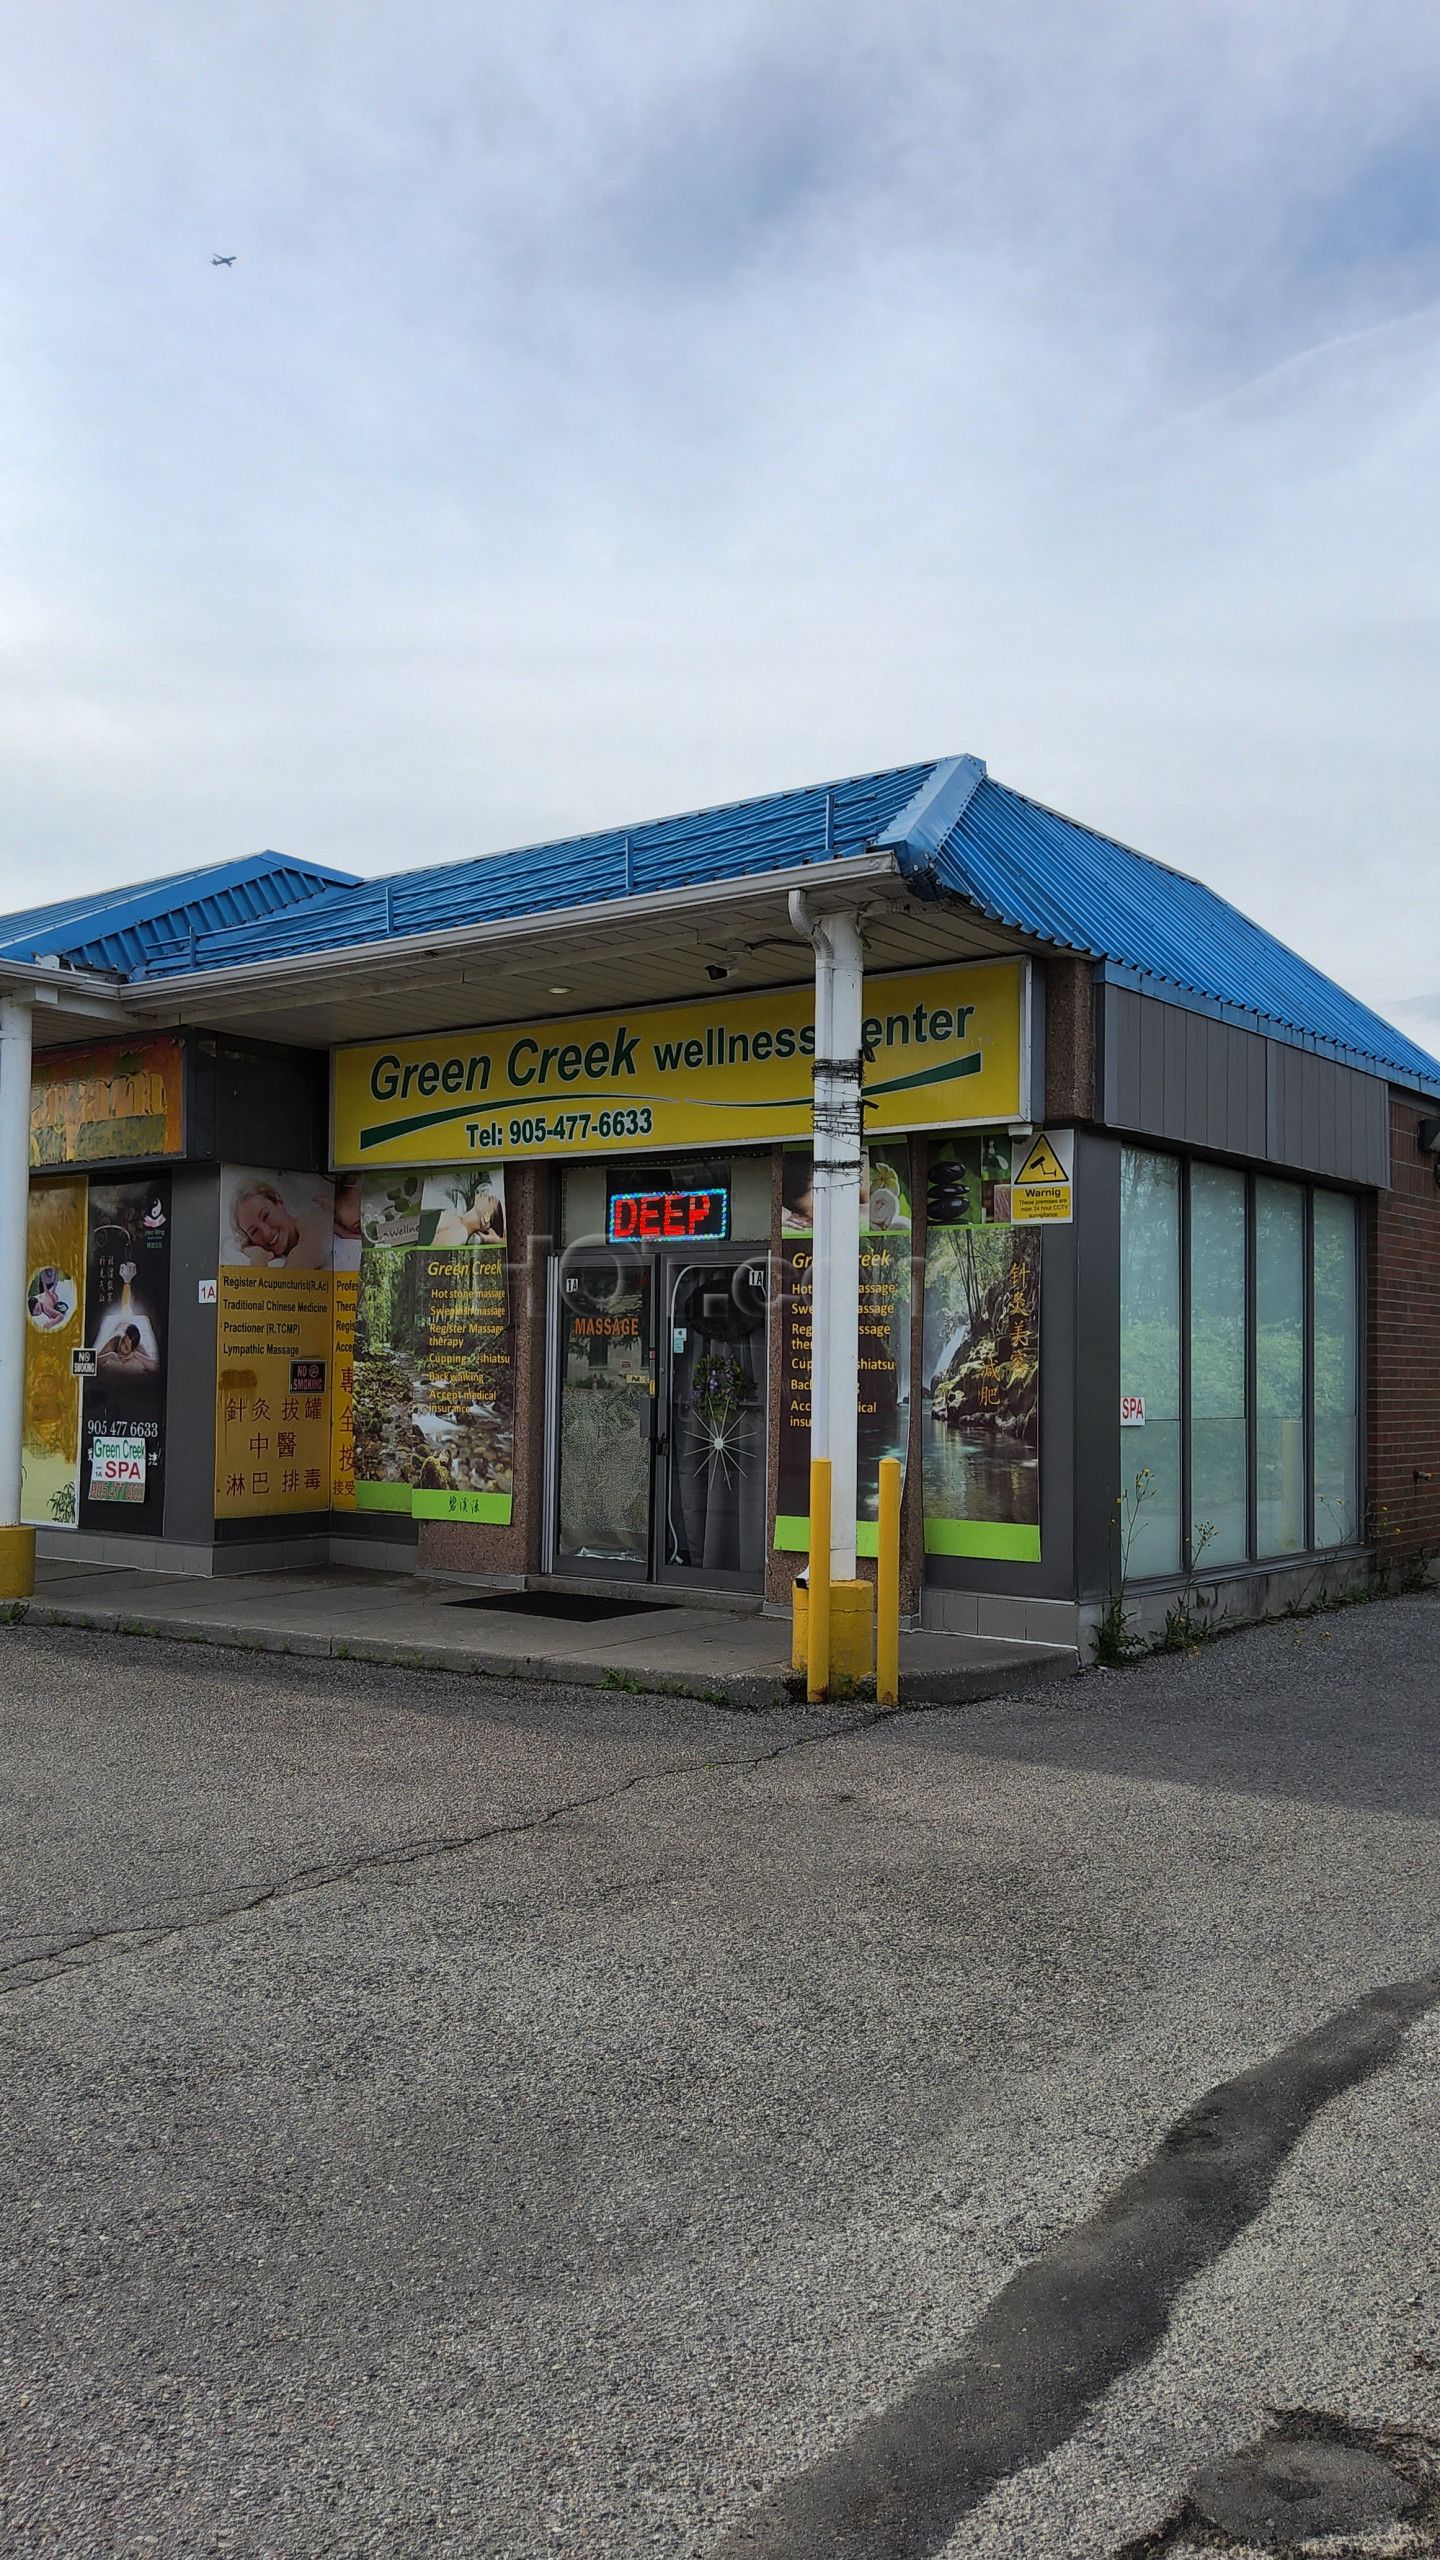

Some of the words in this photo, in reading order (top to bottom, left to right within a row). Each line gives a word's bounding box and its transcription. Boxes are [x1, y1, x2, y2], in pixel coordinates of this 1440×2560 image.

[370, 1053, 492, 1100] Green
[506, 1026, 641, 1088] Creek
[861, 1003, 975, 1047] enter
[465, 1122, 503, 1148] Tel:
[509, 1107, 653, 1145] 905-477-6633
[1025, 1188, 1061, 1198] Warnig
[614, 1195, 711, 1238] DEEP
[428, 1261, 469, 1276] Green
[472, 1260, 502, 1275] Creek
[223, 1276, 257, 1290] Register
[751, 1272, 763, 1285] 1A
[336, 1280, 359, 1291] Profes
[567, 1280, 577, 1292] 1A
[858, 1284, 896, 1296] assage
[201, 1286, 216, 1299] 1A
[431, 1289, 448, 1299] Hot
[449, 1289, 474, 1299] stone
[476, 1289, 506, 1301] massage
[223, 1299, 264, 1311] Traditional
[266, 1301, 296, 1312] Chinese
[297, 1302, 328, 1313] Medicine
[336, 1300, 356, 1312] Thera
[475, 1306, 506, 1318] massage
[857, 1304, 895, 1316] assage
[223, 1321, 264, 1333] Practioner
[266, 1323, 301, 1336] (R.TCMP)
[336, 1320, 356, 1334] Regis
[429, 1323, 466, 1336] Register
[575, 1317, 639, 1336] MASSAGE
[792, 1323, 814, 1337] Reg
[858, 1325, 891, 1337] ssage
[429, 1336, 464, 1348] therapy
[223, 1343, 264, 1357] Lympathic
[266, 1344, 300, 1357] Massage
[78, 1352, 91, 1362] NO
[480, 1353, 511, 1364] shiatsu
[74, 1362, 95, 1373] SMOKING
[297, 1364, 307, 1375] NO
[429, 1371, 448, 1381] Back
[450, 1371, 484, 1384] walking
[292, 1379, 322, 1391] SMOKING
[429, 1390, 461, 1402] Accept
[463, 1390, 497, 1401] medical
[429, 1402, 470, 1414] insurance
[1122, 1398, 1144, 1419] SPA
[87, 1420, 108, 1435] 905
[110, 1421, 128, 1436] 477
[130, 1422, 158, 1437] 6633
[94, 1439, 120, 1460] Green
[122, 1440, 145, 1460] Creek
[104, 1460, 141, 1479] SPA
